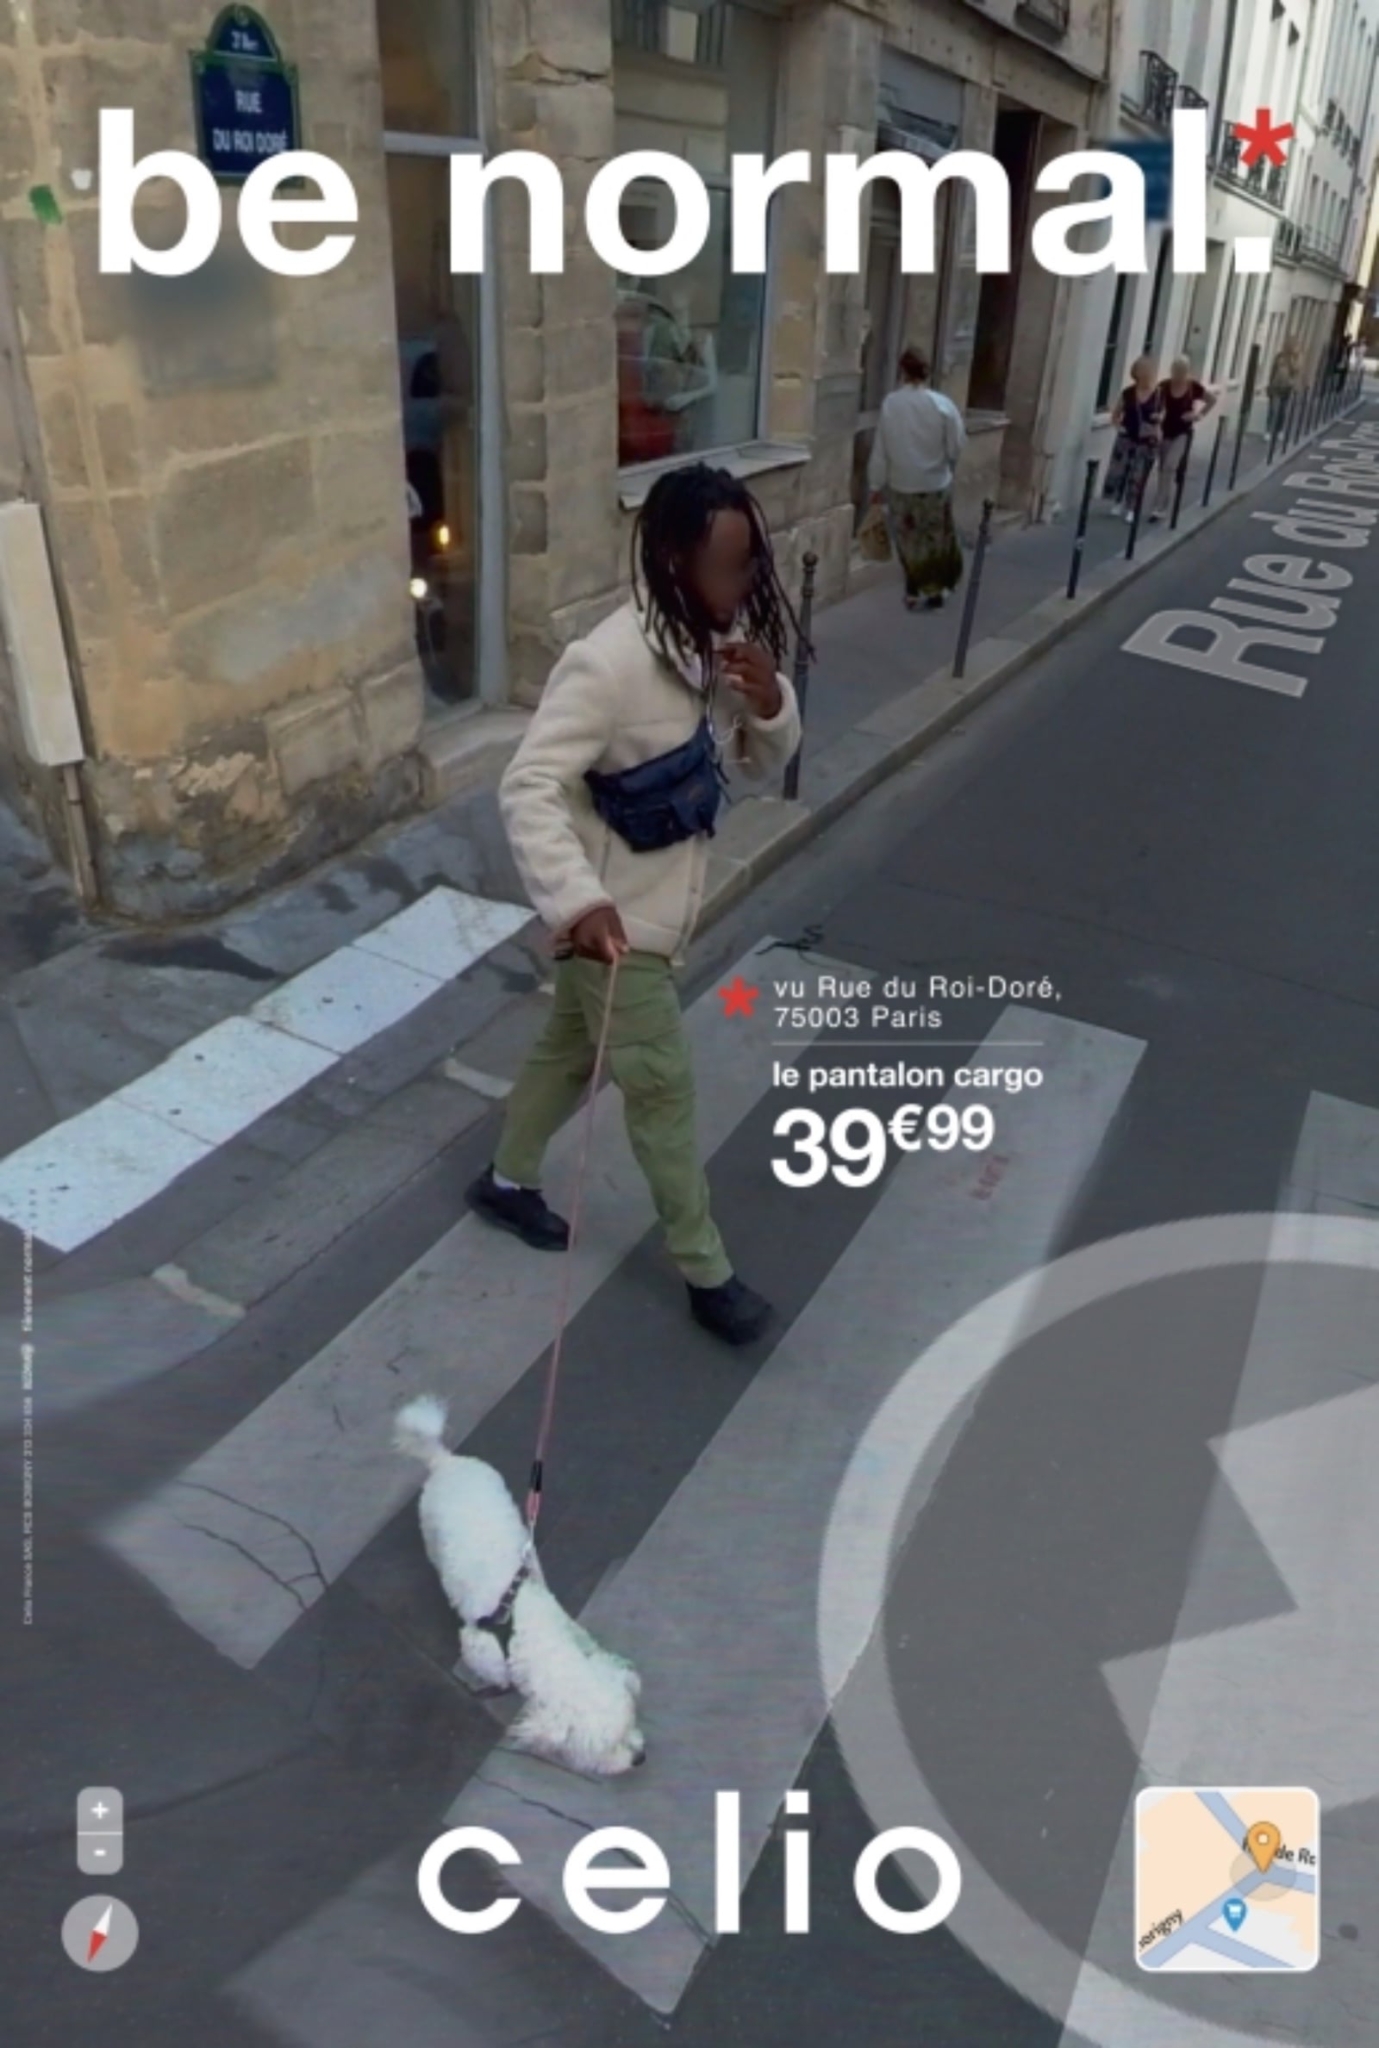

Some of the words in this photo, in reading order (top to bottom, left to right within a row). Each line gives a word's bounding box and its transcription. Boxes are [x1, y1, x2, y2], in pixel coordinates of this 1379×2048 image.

[236, 90, 262, 113] RUE
[212, 129, 231, 152] DU
[234, 130, 255, 154] ROI
